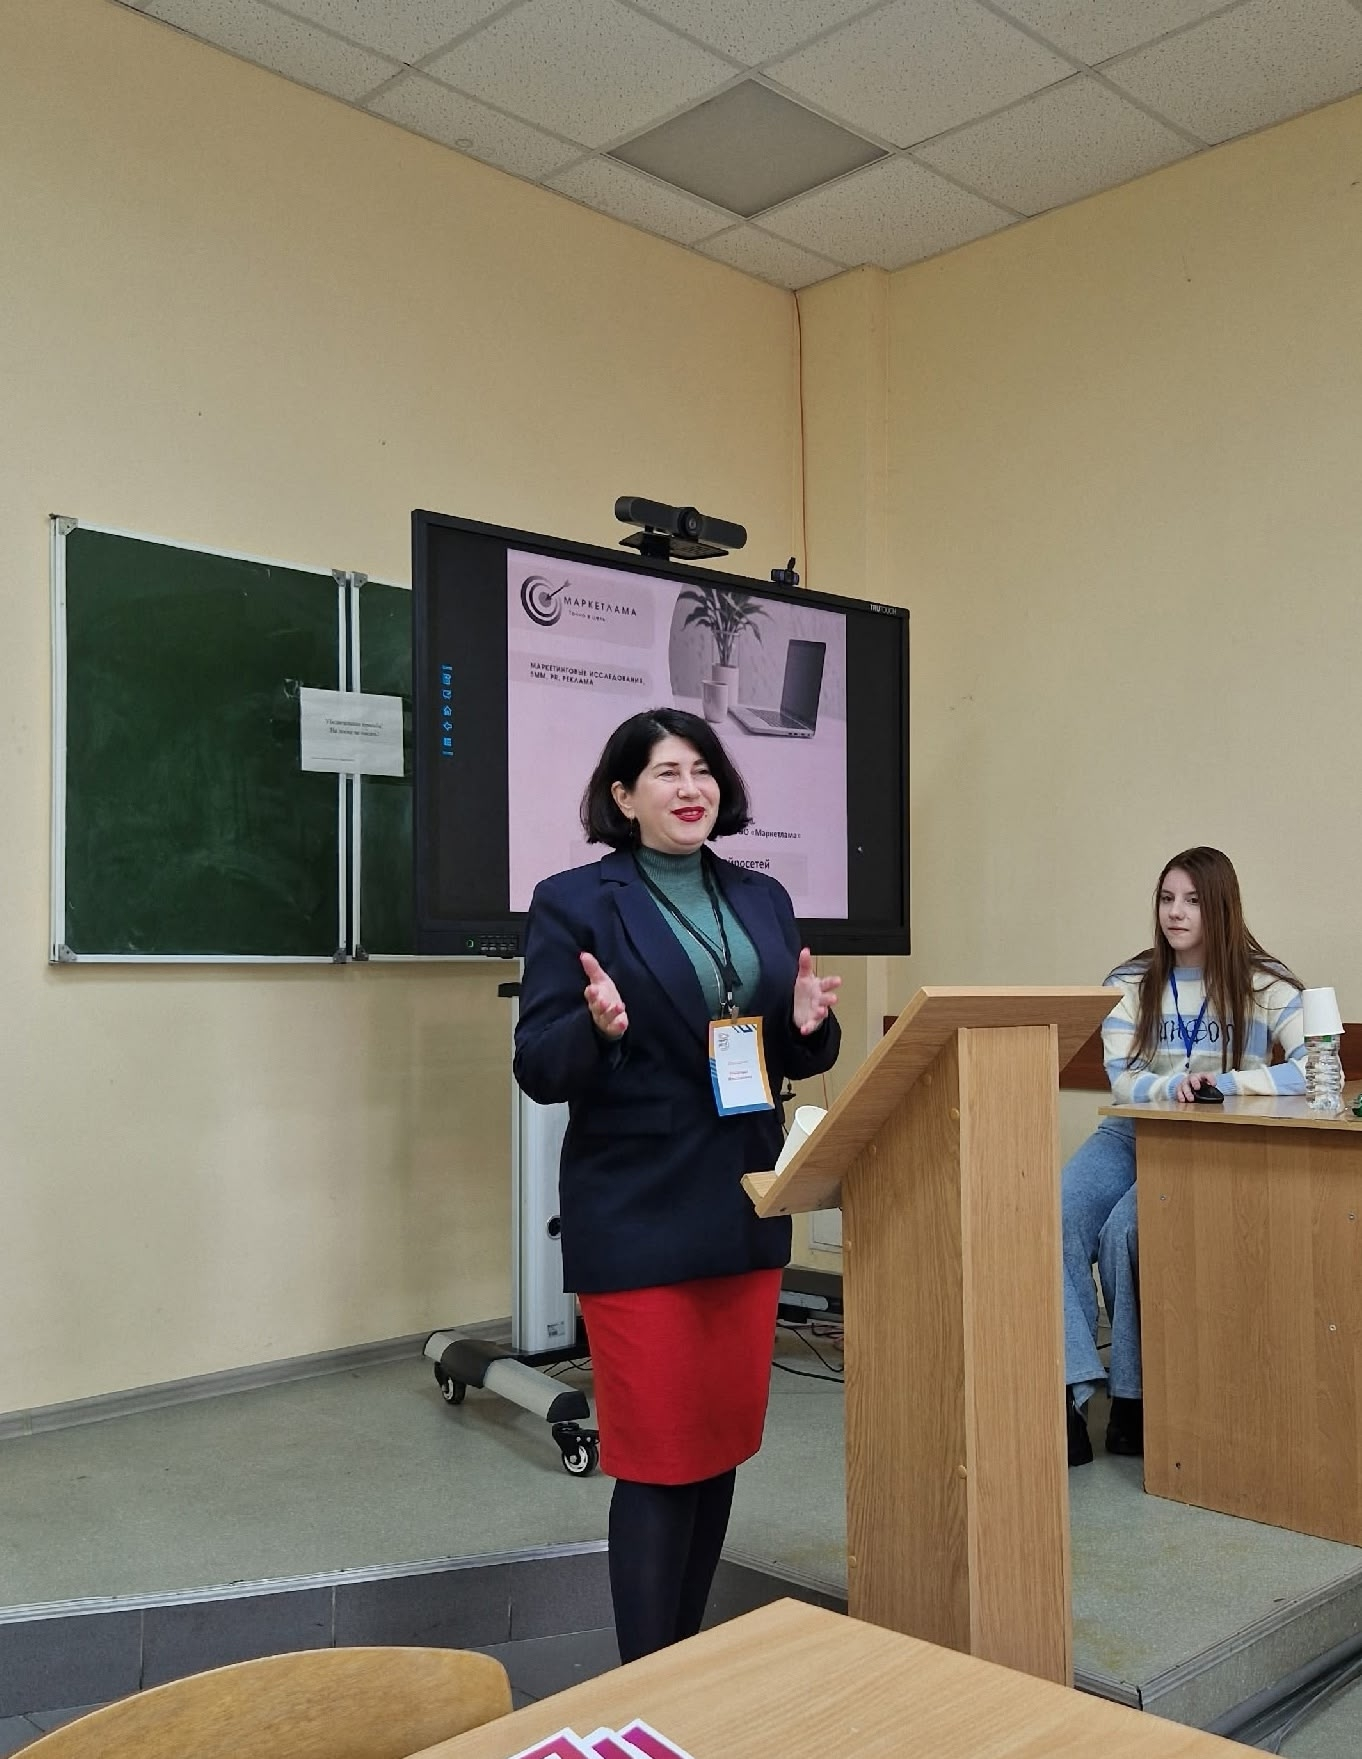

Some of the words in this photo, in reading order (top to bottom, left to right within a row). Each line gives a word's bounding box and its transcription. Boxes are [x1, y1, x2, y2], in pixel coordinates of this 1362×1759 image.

[563, 596, 637, 617] МАРКЕТЛАМА
[530, 662, 587, 677] МАРКЕТИНГОВЫЕ
[562, 675, 594, 686] РЕКЛАМА
